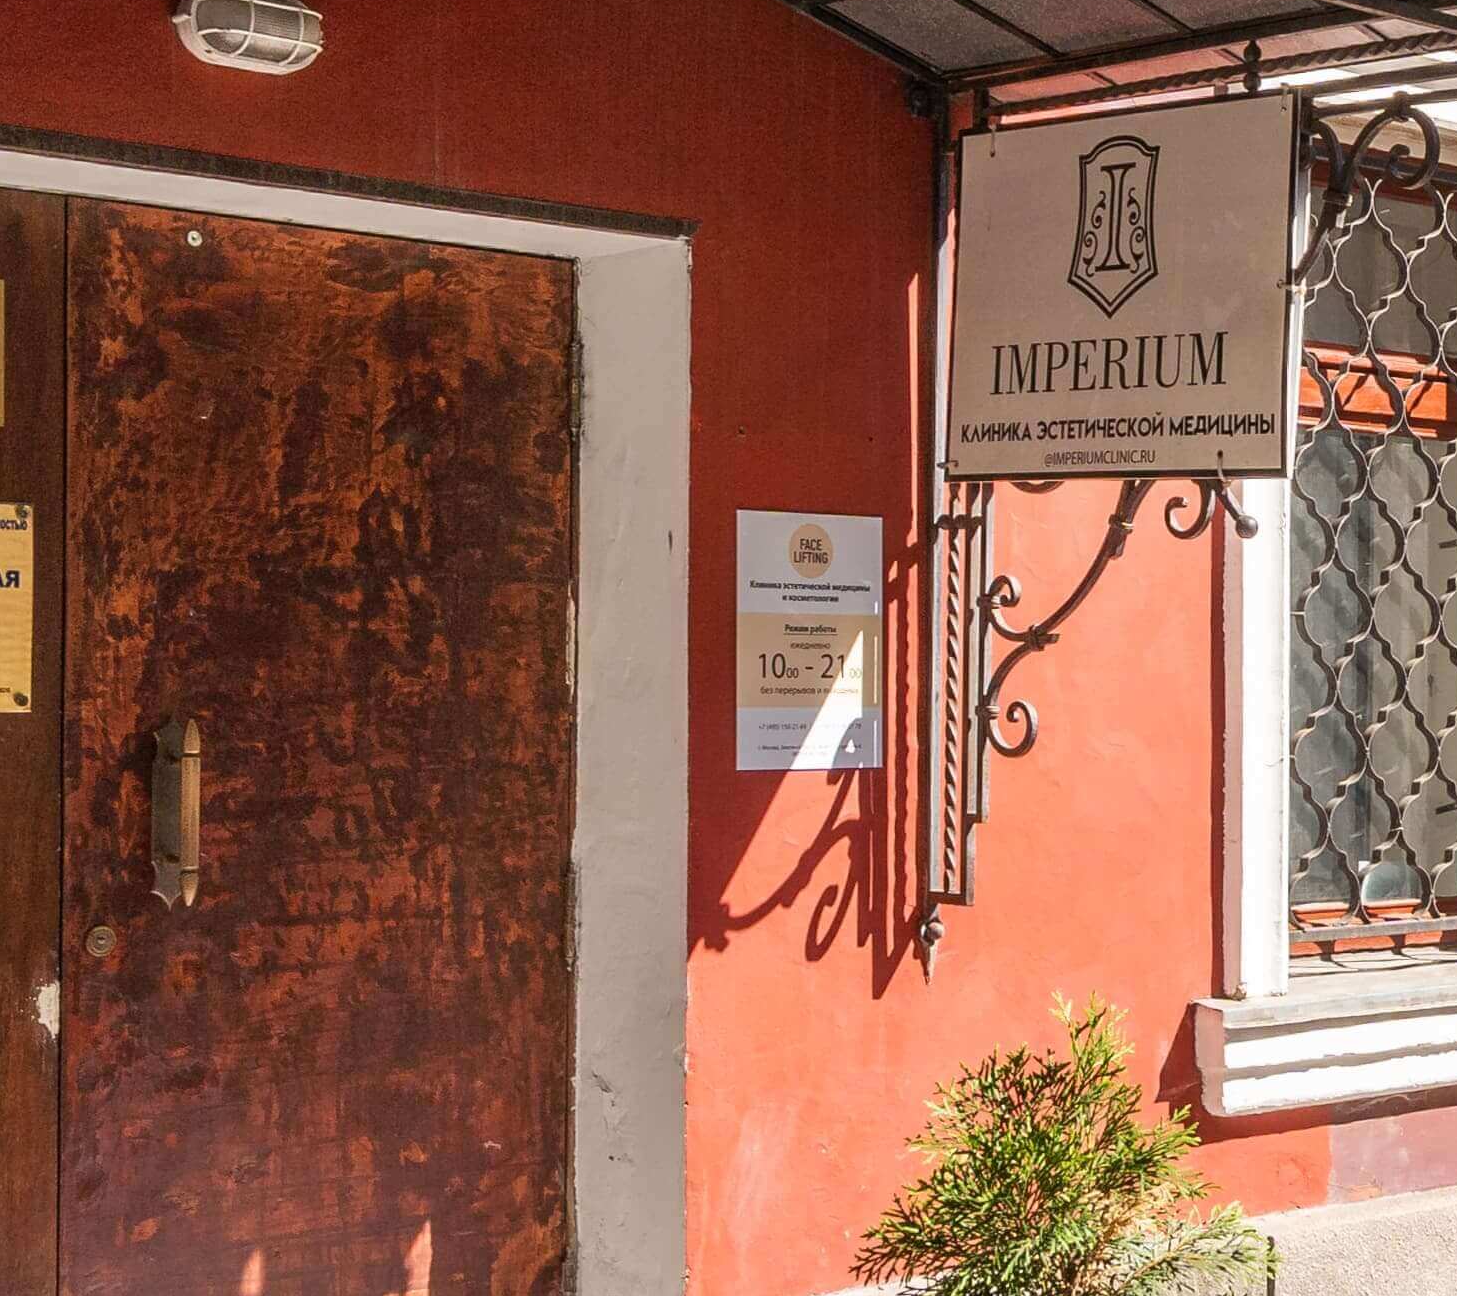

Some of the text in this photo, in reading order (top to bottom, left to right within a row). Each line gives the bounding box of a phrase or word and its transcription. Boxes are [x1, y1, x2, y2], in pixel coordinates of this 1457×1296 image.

[990, 331, 1229, 395] IMPERIUM
[961, 412, 1275, 443] КЛИНИКА ЭСТЕТИЧЕСКОЙ МЕДИЦИНЫ
[1044, 450, 1156, 467] @IMPERIUMCLINIC.RU
[799, 538, 822, 551] FACE
[794, 551, 828, 565] LIFTING
